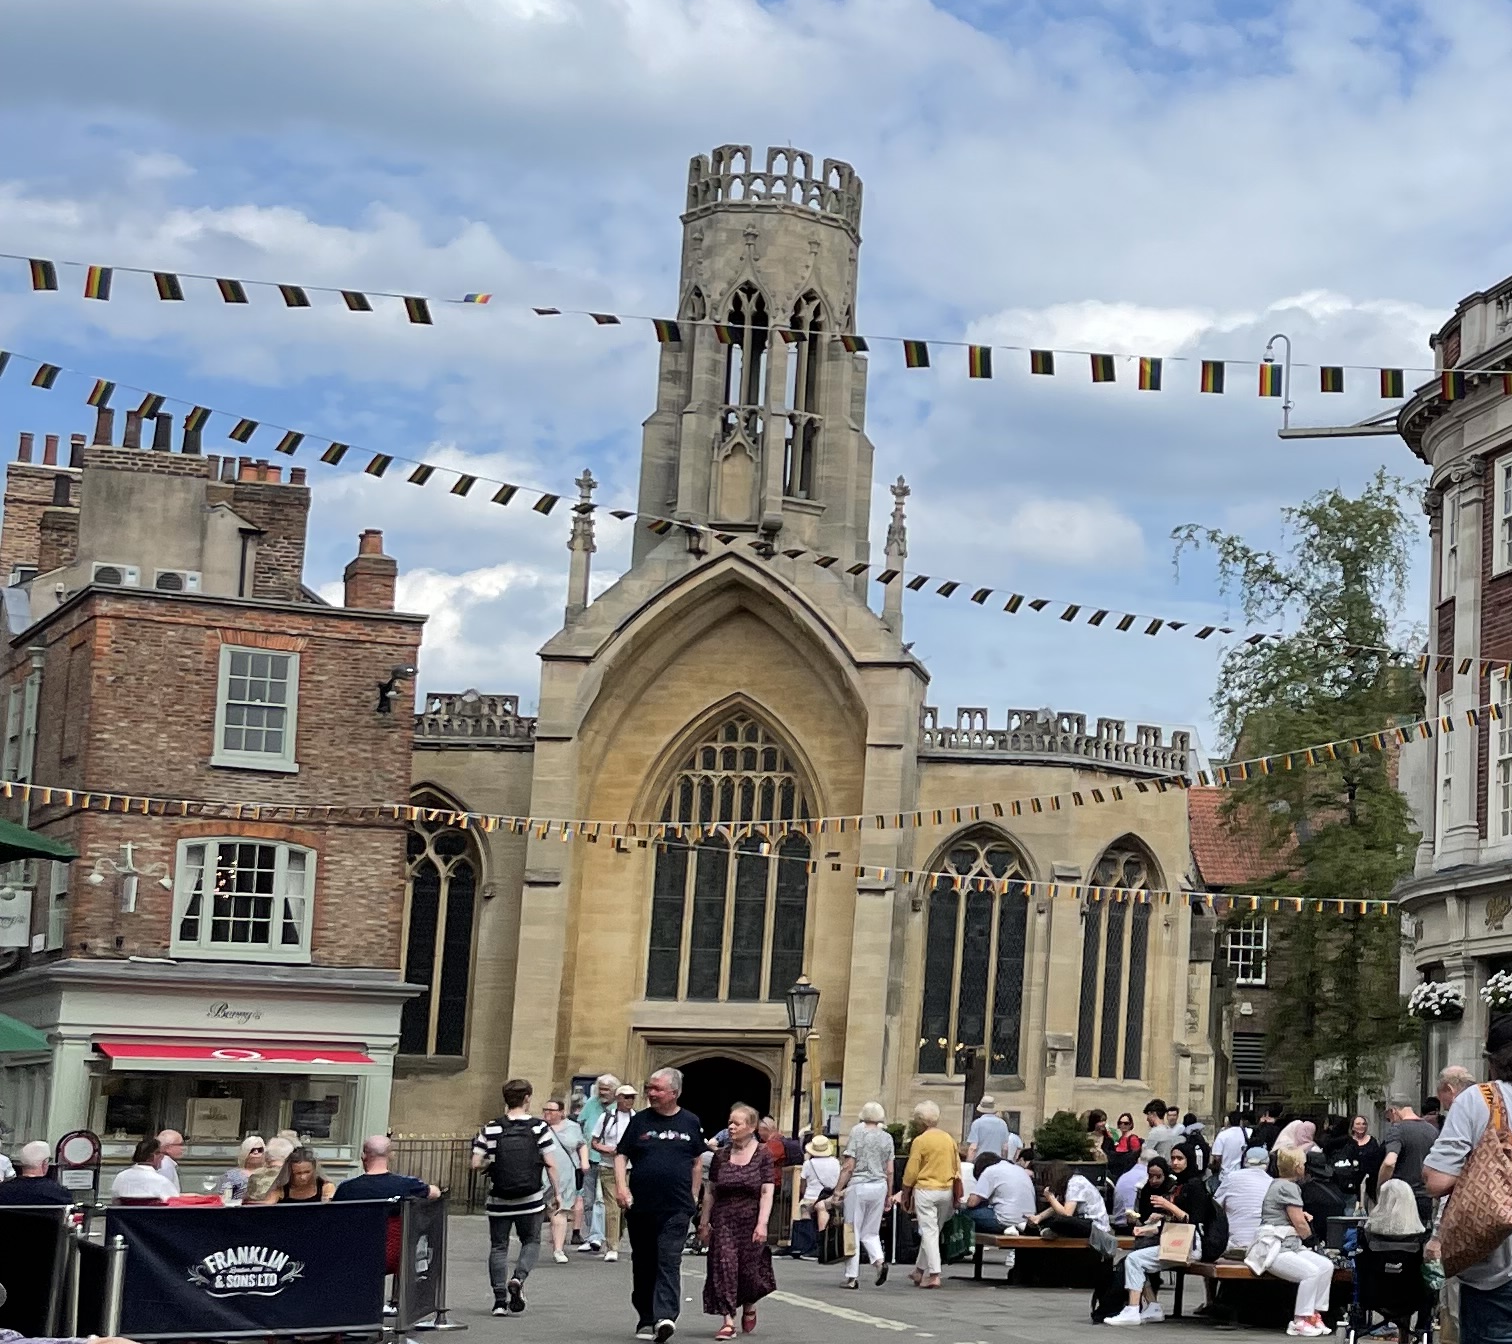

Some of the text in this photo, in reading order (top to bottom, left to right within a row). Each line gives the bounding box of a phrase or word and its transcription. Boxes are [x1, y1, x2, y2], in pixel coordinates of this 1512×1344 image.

[203, 1246, 290, 1274] FRANKLIN
[214, 1273, 278, 1288] & SONS LTD
